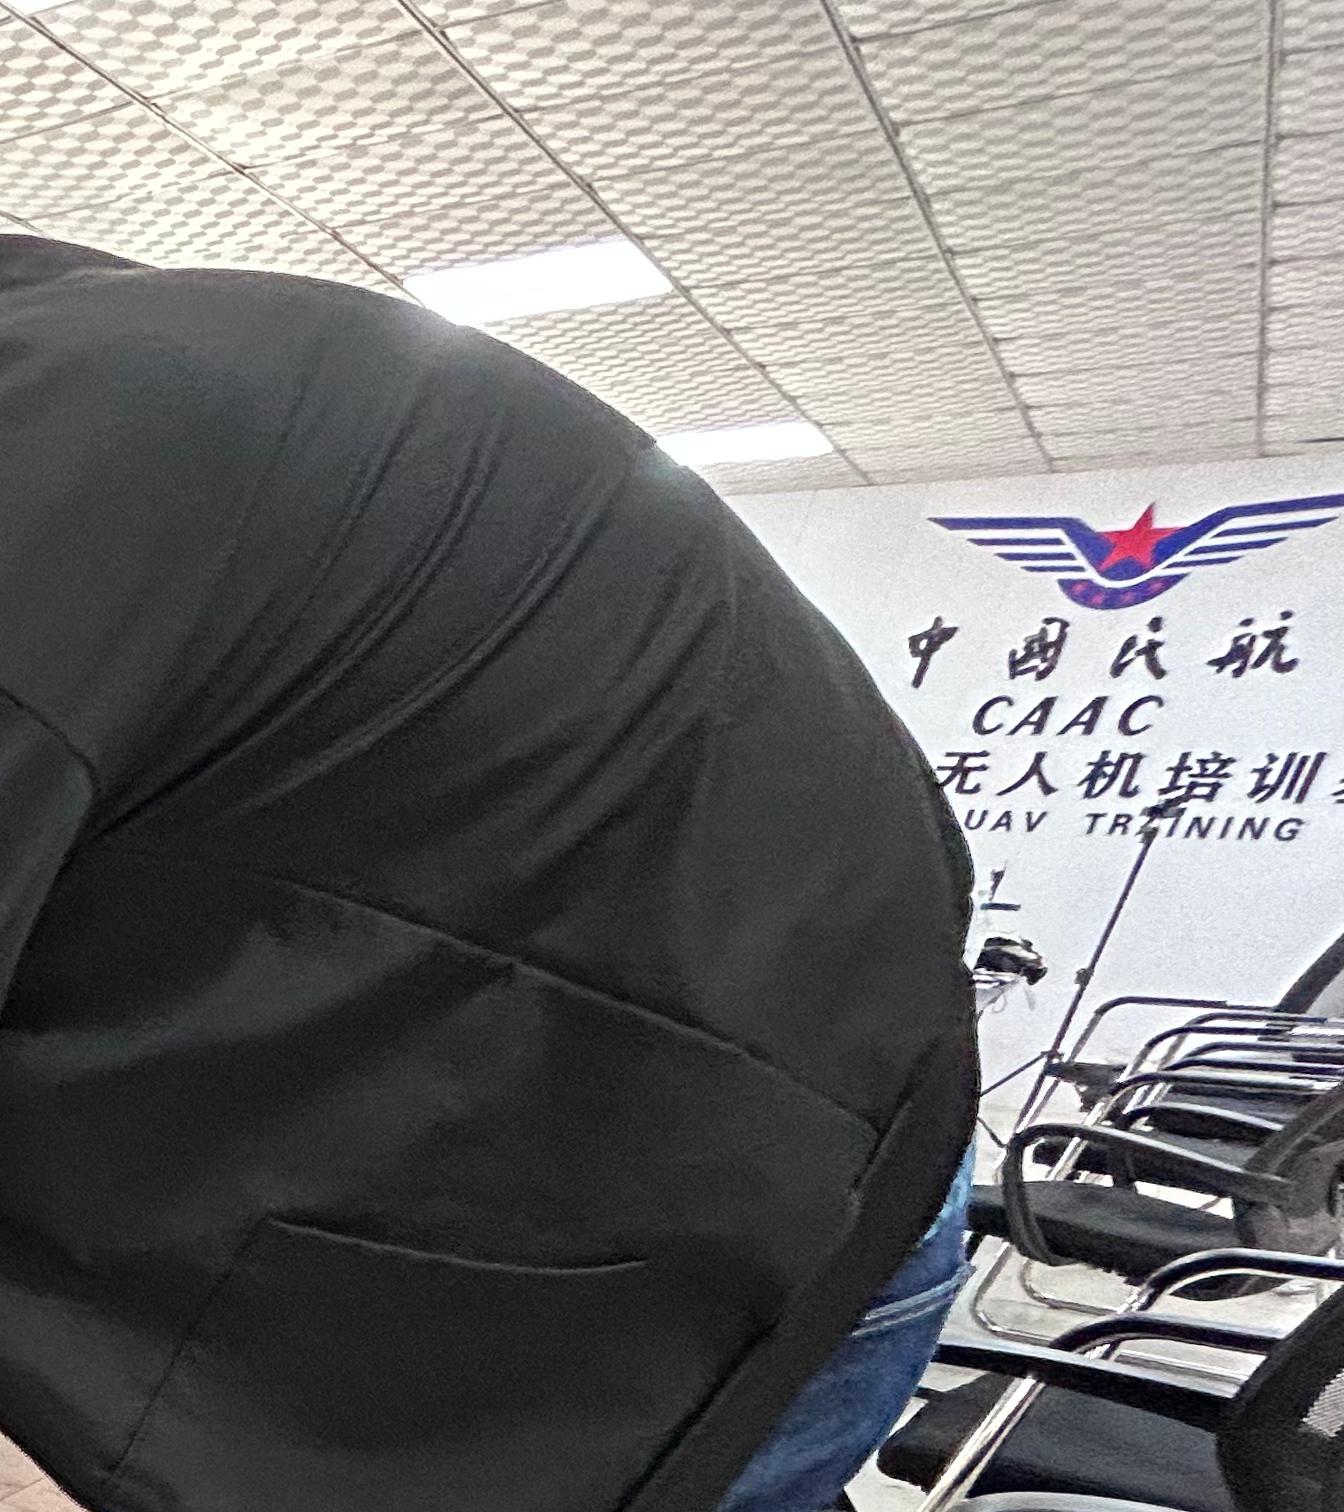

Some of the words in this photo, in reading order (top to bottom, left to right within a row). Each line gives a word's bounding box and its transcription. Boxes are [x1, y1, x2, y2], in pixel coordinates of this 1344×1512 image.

[908, 611, 1300, 689] 中国民航
[972, 695, 1164, 737] CAAC
[963, 809, 1048, 833] UAV
